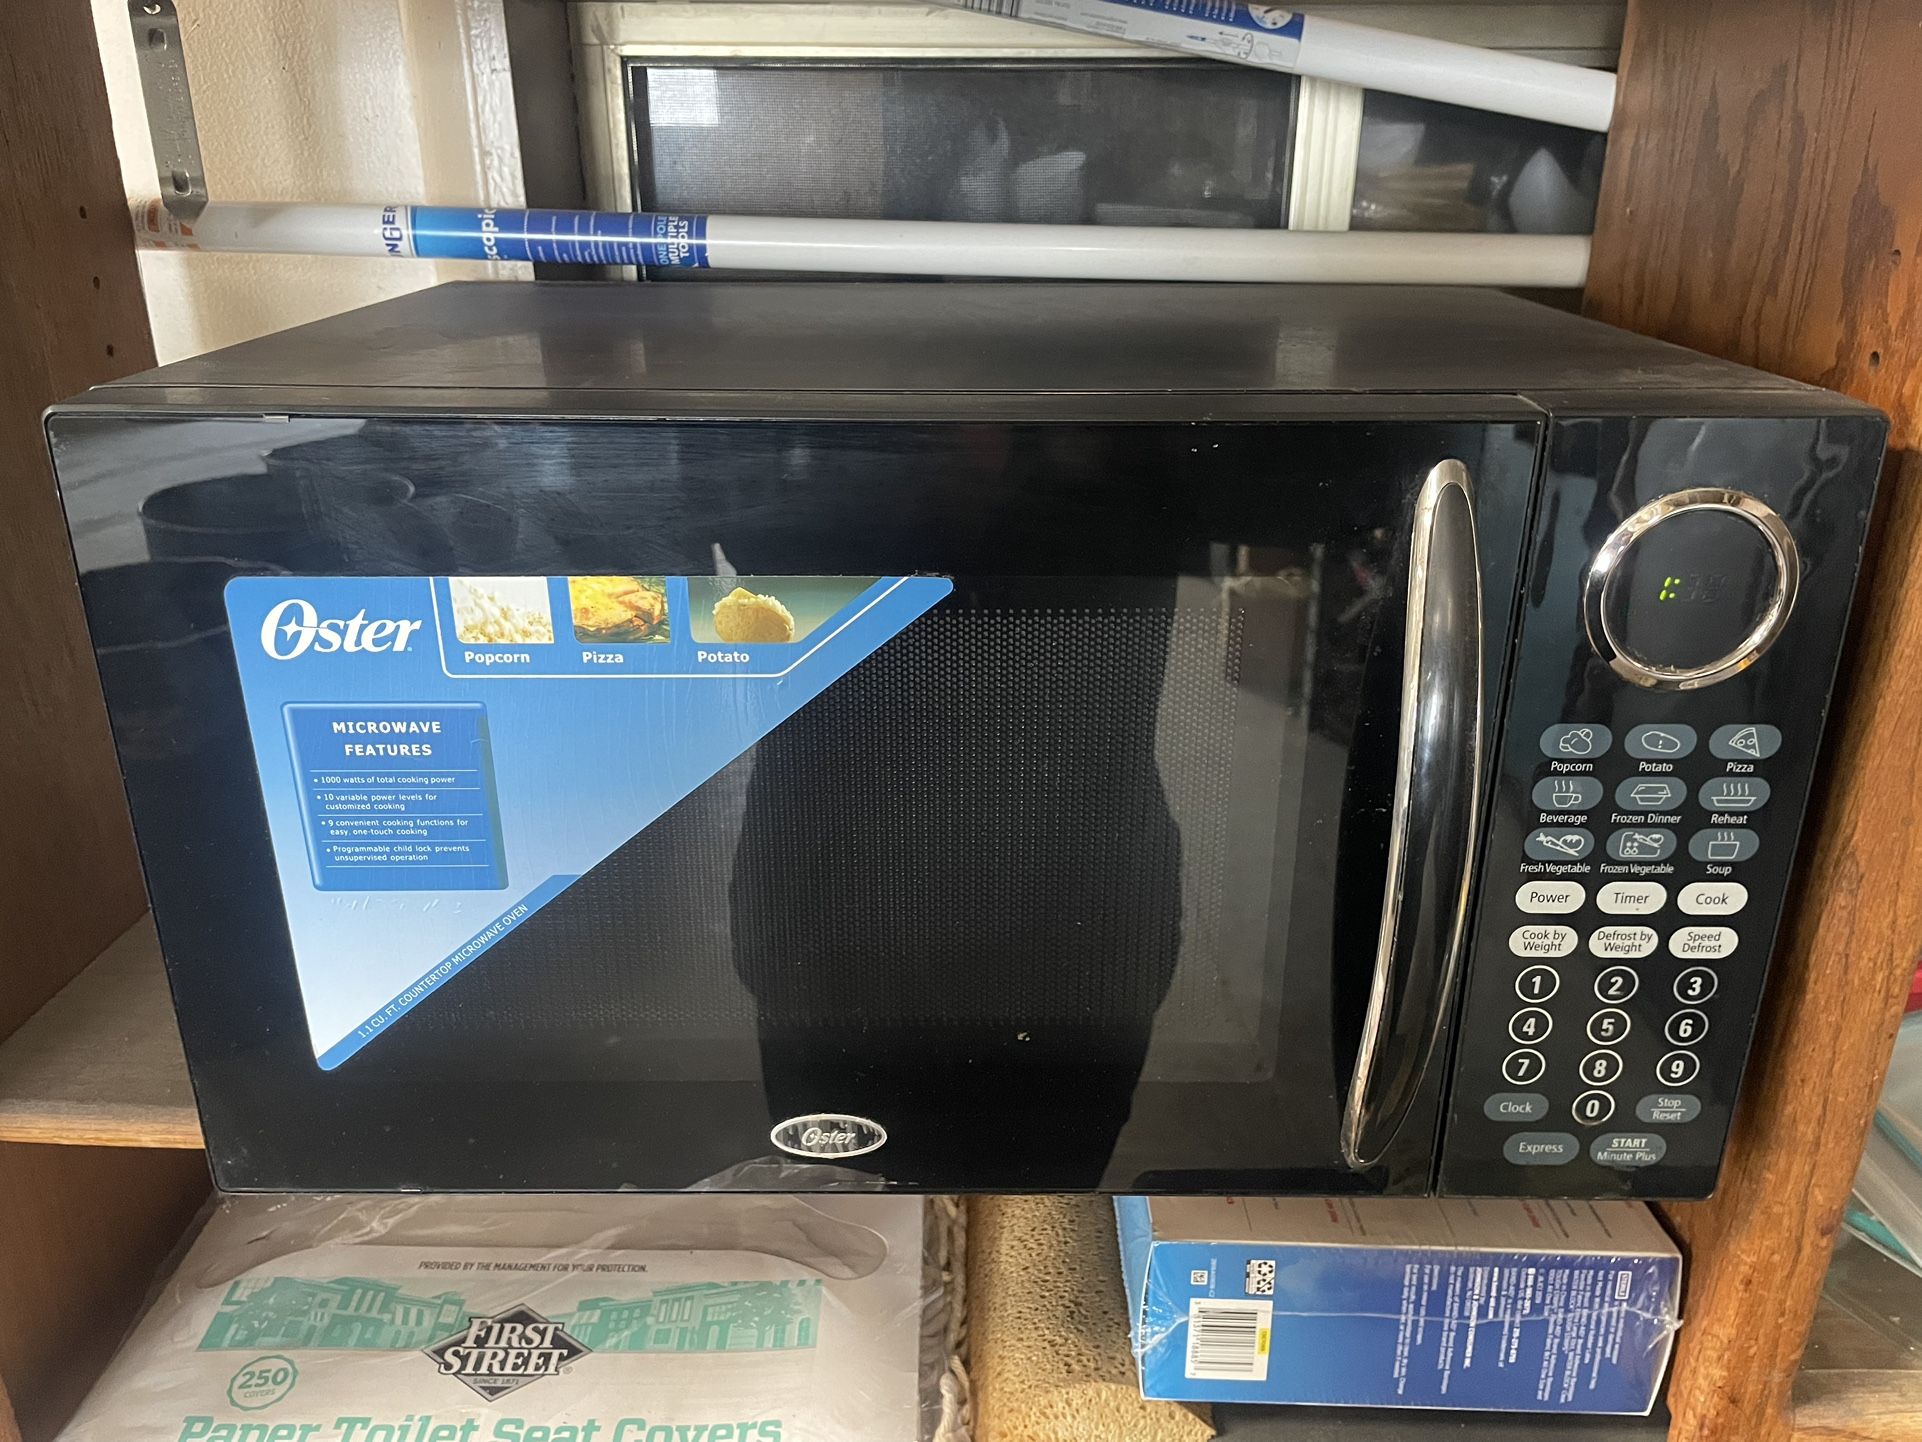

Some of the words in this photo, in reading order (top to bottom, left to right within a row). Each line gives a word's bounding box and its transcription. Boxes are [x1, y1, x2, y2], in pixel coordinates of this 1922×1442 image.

[382, 206, 402, 257] NGER
[668, 216, 680, 265] MULTIPLE
[679, 221, 690, 258] TOOLS
[657, 244, 669, 265] ONE
[261, 599, 422, 661] Oster
[464, 651, 531, 665] Popcorn
[582, 651, 624, 664] Pizza
[698, 650, 750, 664] Potato
[332, 721, 441, 734] MICROWAVE
[344, 744, 432, 756] FEATURES
[1550, 761, 1593, 773] Popcorn
[1639, 761, 1673, 773] Potato
[1726, 762, 1754, 773] Pizza
[321, 776, 341, 784] 1000
[343, 776, 365, 784] watts
[367, 776, 376, 784] of
[376, 776, 395, 784] total
[397, 776, 428, 785] cooking
[431, 777, 455, 785] power
[336, 793, 368, 801] variable
[371, 794, 396, 802] power
[399, 793, 422, 801] levels
[425, 793, 437, 801] for
[374, 803, 405, 811] cooking
[383, 819, 414, 828] cooking
[1539, 813, 1588, 825] Beverage
[1611, 813, 1645, 823] Frozen
[1647, 813, 1682, 824] Dinner
[1710, 813, 1748, 824] Reheat
[396, 828, 428, 836] cooking
[333, 845, 390, 854] Programmable
[435, 845, 469, 853] prevents
[334, 854, 387, 862] unsupervised
[390, 854, 428, 862] operation
[1520, 863, 1544, 873] Fresh
[1545, 863, 1591, 875] Vegetable
[1600, 863, 1628, 873] Frozen
[1629, 863, 1674, 875] Vegetable
[1705, 864, 1732, 876] Soup
[1530, 892, 1570, 904] Power
[1614, 892, 1650, 904] Timer
[1695, 893, 1729, 905] Cook
[1522, 930, 1550, 940] Cook
[1553, 930, 1567, 942] by
[1597, 930, 1637, 941] Defrost
[1640, 931, 1653, 943] by
[1687, 932, 1721, 944] Speed
[1523, 940, 1562, 952] Weight
[1603, 942, 1642, 953] Weight
[1682, 943, 1722, 953] Defrost
[357, 1023, 373, 1039] 1.1
[371, 1013, 389, 1029] CU.
[385, 1003, 401, 1018] FT.
[398, 961, 453, 1007] COUNTERTOP
[452, 922, 505, 966] MICROWAVE
[502, 903, 529, 926] OVEN
[1531, 975, 1541, 994] 1
[1607, 976, 1622, 995] 2
[1687, 977, 1702, 996] 3
[1522, 1018, 1536, 1036] 4
[1600, 1018, 1615, 1036] 5
[1679, 1019, 1693, 1037] 6
[1517, 1059, 1530, 1076] 7
[1593, 1060, 1607, 1078] 8
[1670, 1060, 1685, 1078] 9
[1500, 1102, 1533, 1113] Clock
[1586, 1100, 1600, 1118] 0
[1658, 1098, 1682, 1108] Stop
[1652, 1111, 1681, 1120] Reset
[802, 1127, 856, 1146] Oster
[1519, 1142, 1564, 1155] Express
[1611, 1138, 1647, 1148] START
[1597, 1152, 1633, 1161] Minute
[1635, 1152, 1656, 1161] Plus
[418, 1261, 461, 1270] PROVIDED
[462, 1262, 473, 1270] BY
[475, 1262, 491, 1271] THE
[493, 1262, 551, 1272] MANAGEMENT
[552, 1263, 569, 1272] FOR
[595, 1263, 648, 1273] PROTECTION.
[461, 1317, 564, 1349] FIRST
[438, 1346, 568, 1376] STREET
[238, 1367, 290, 1390] 250
[473, 1377, 499, 1385] SINCE
[243, 1388, 276, 1399] COVERS
[327, 1414, 480, 1442] Toilet
[492, 1417, 602, 1442] Seat
[612, 1417, 783, 1442] Covers
